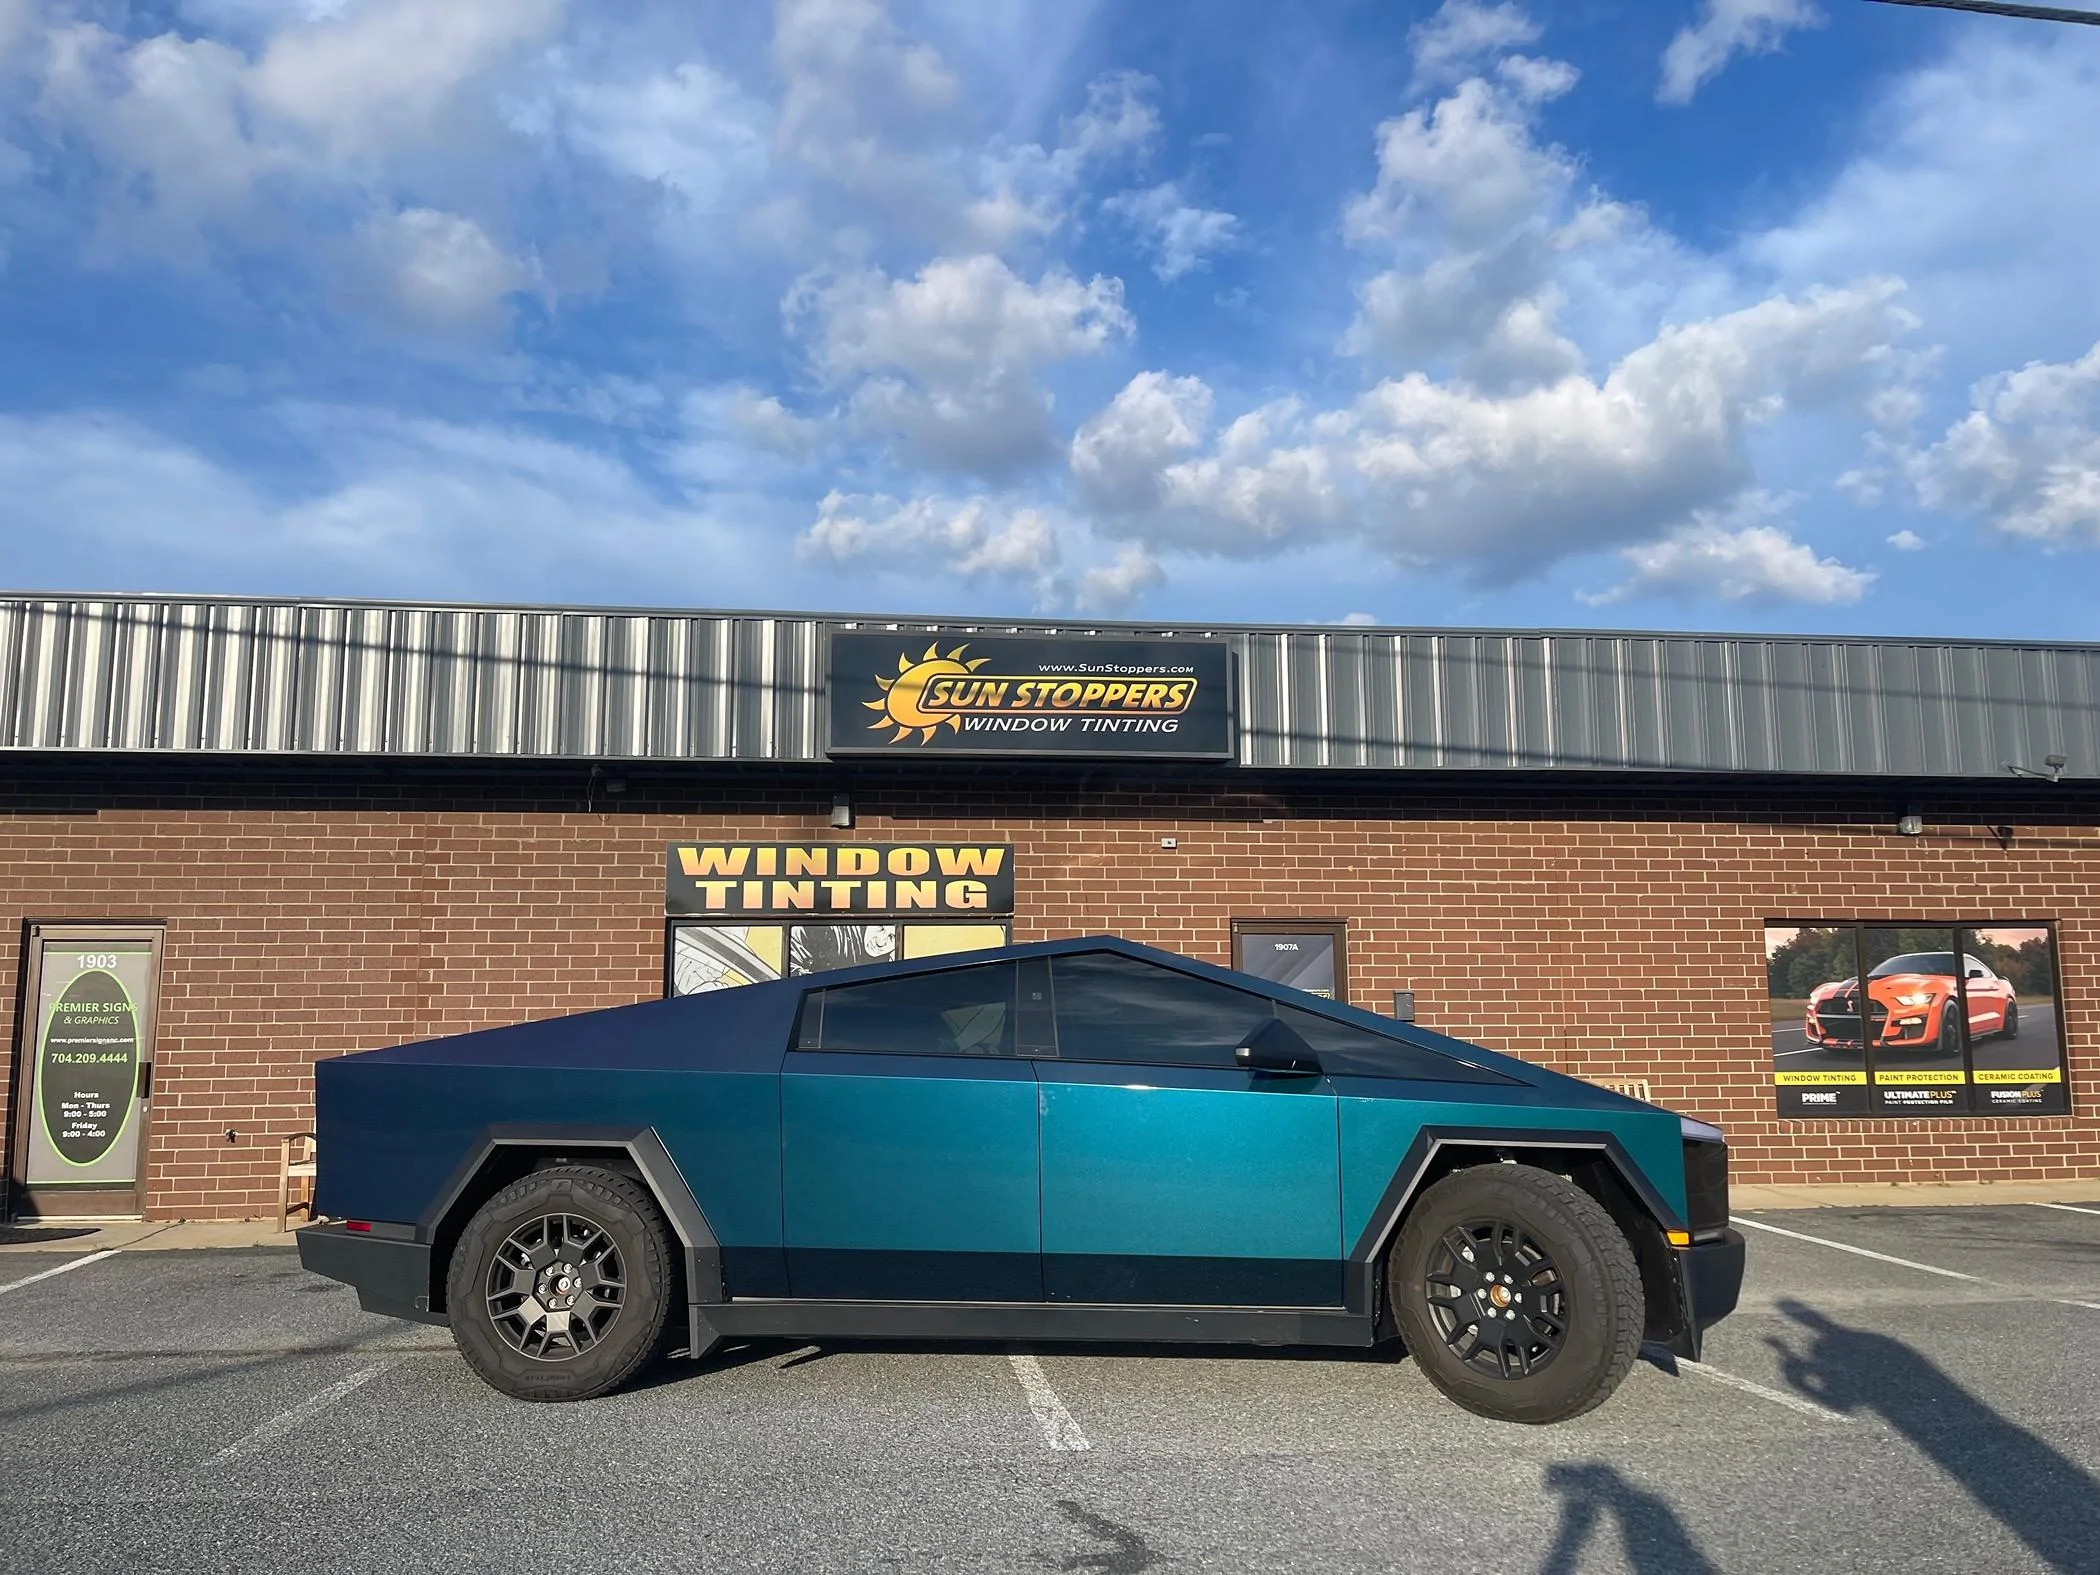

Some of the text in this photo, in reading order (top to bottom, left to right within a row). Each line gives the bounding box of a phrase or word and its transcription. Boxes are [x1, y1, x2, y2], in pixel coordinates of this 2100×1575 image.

[928, 682, 1188, 709] SUN STOPPERS
[964, 717, 1179, 732] WINDOW TINTING
[677, 847, 1005, 876] WINDOW
[695, 880, 988, 909] TINTING
[1274, 943, 1299, 951] 1907A
[77, 954, 117, 969] 1903
[49, 1002, 138, 1012] PREMIER SIGNS
[63, 1016, 119, 1025] & GRAPHICS
[51, 1053, 128, 1064] 704.209.4444
[74, 1091, 99, 1099] Hours
[1801, 1093, 1837, 1102] PRIME
[71, 1122, 98, 1130] Friday
